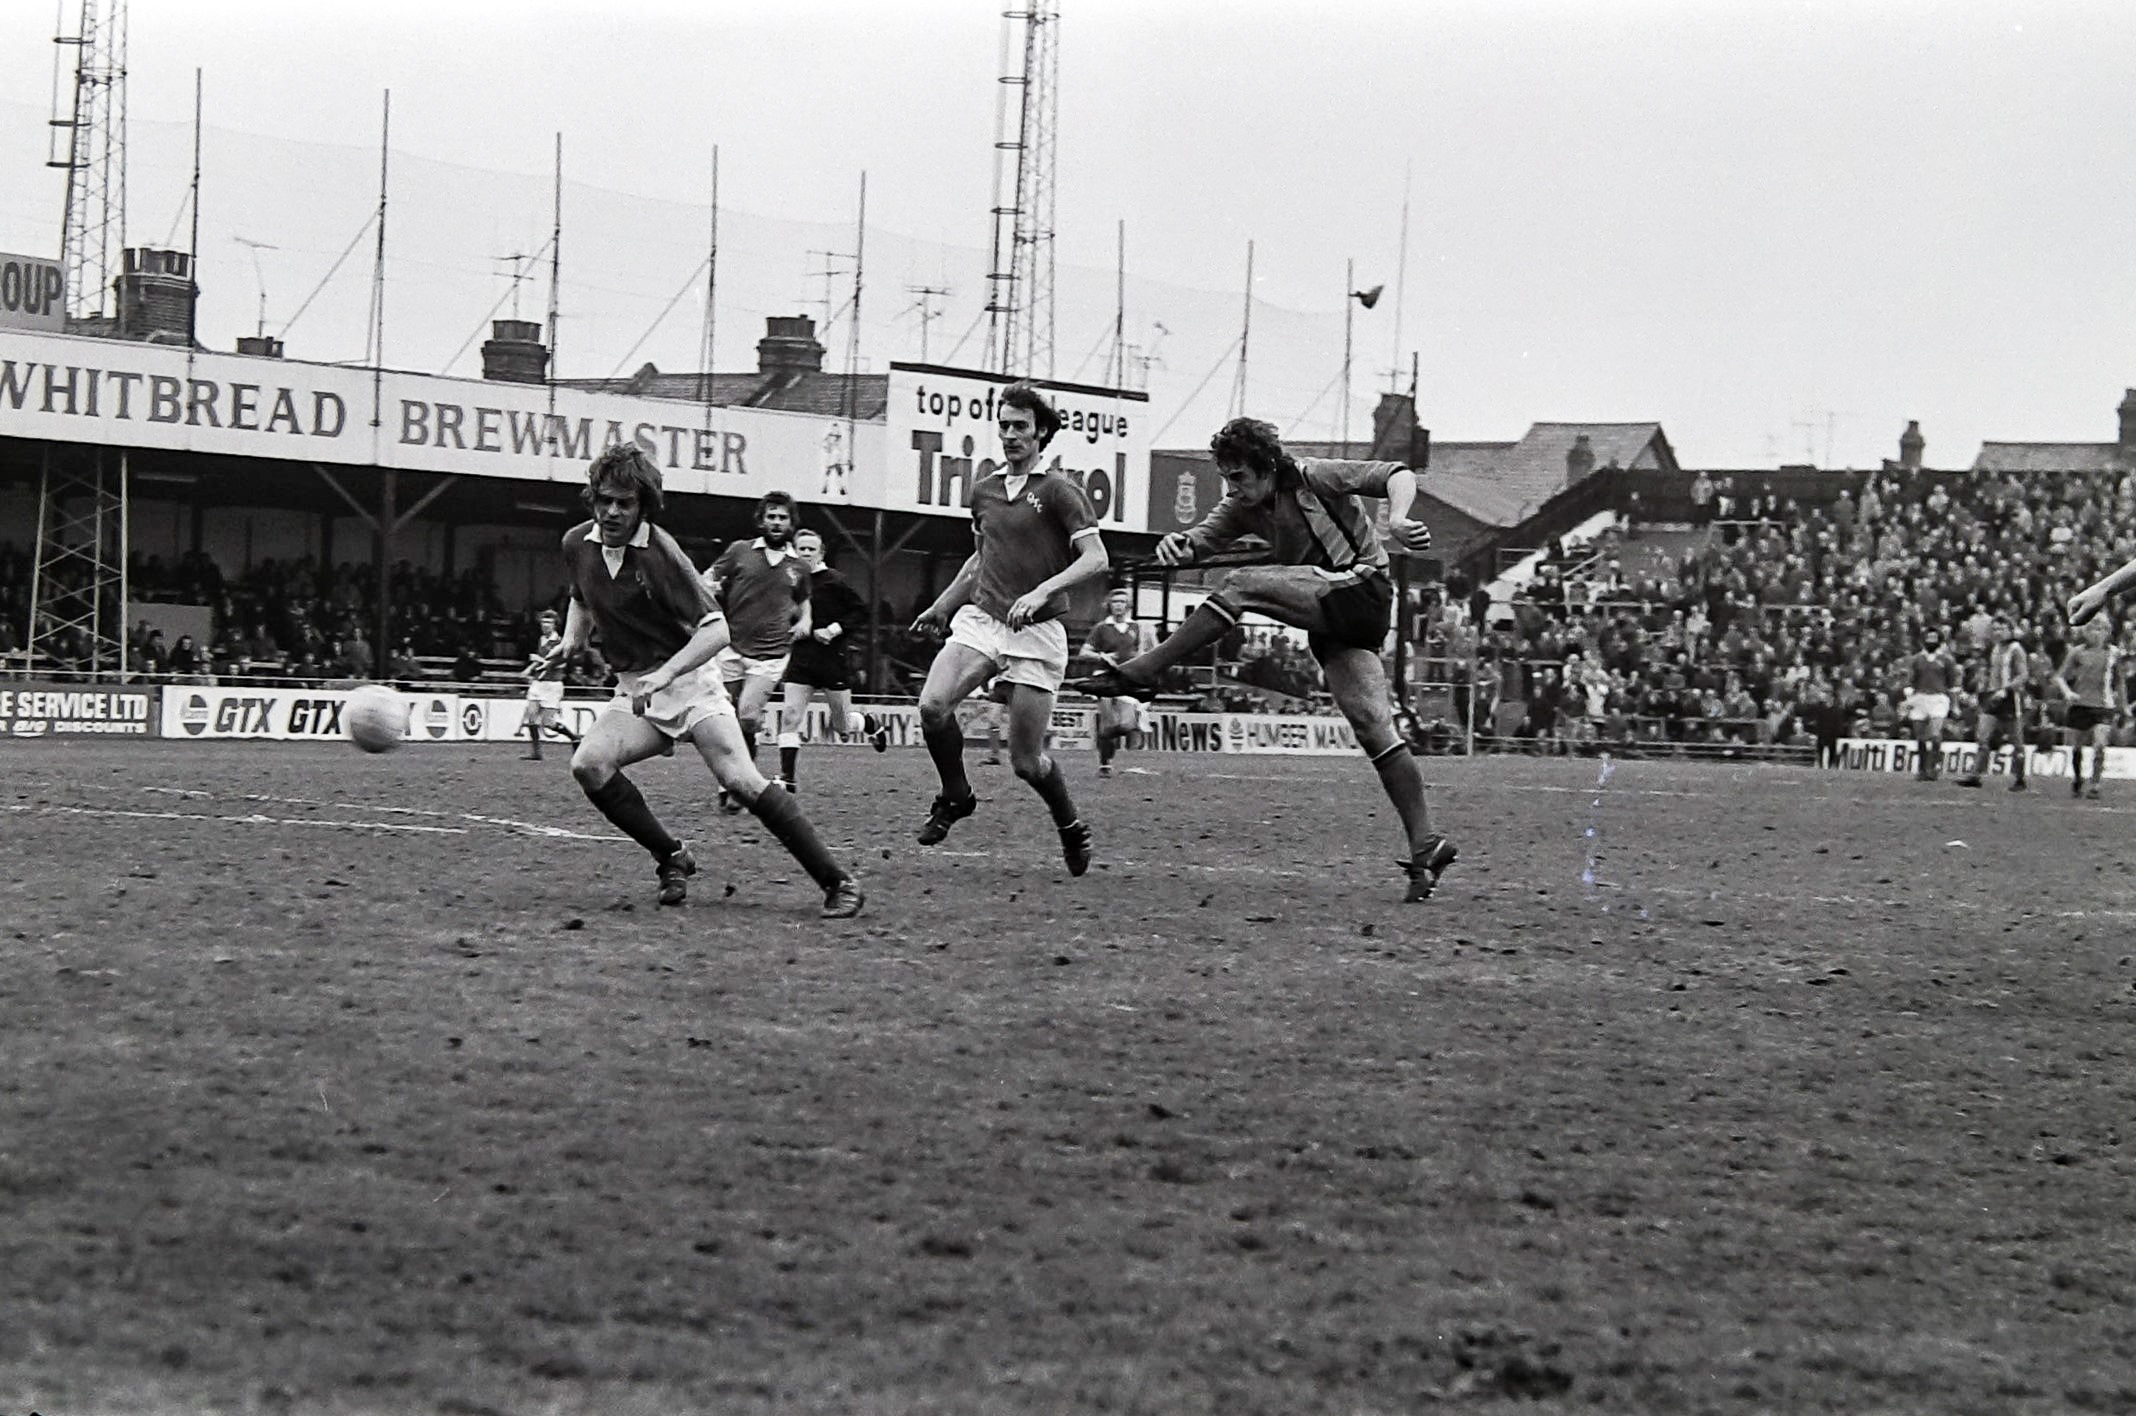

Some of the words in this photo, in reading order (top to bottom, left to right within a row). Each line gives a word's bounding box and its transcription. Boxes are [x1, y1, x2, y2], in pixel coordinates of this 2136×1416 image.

[0, 261, 63, 316] OUP
[0, 360, 347, 438] WHITBREAD
[399, 399, 748, 475] BREWMASTER
[916, 385, 962, 427] top
[969, 387, 994, 421] of
[17, 691, 108, 719] SERVICE
[110, 693, 149, 720] LTD
[214, 697, 278, 733] GTX
[287, 698, 347, 735] GTX
[54, 720, 147, 734] DISCOUNTS
[1160, 714, 1222, 752] News
